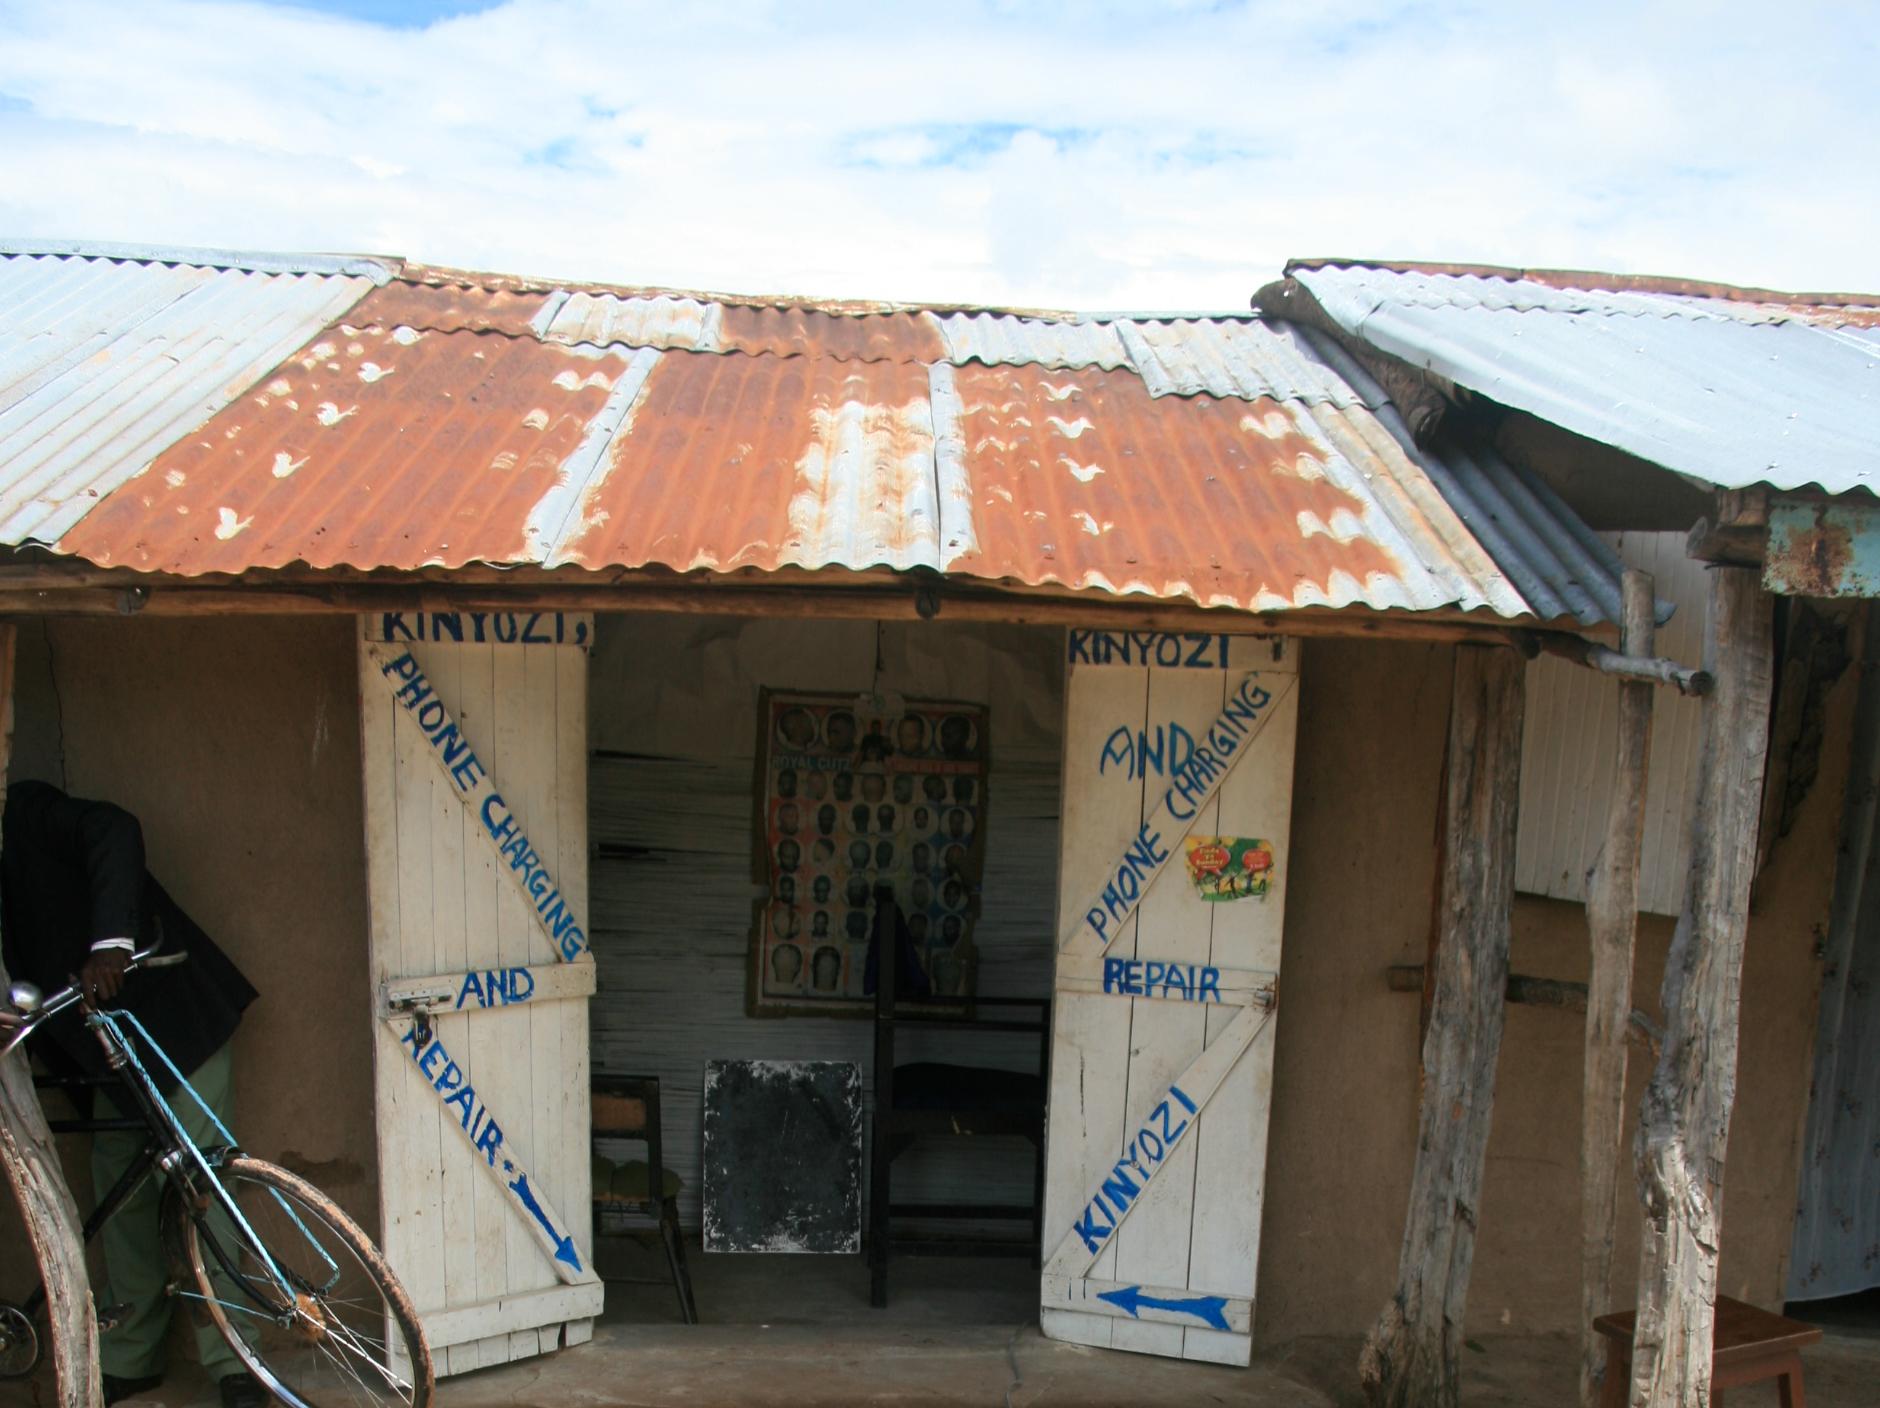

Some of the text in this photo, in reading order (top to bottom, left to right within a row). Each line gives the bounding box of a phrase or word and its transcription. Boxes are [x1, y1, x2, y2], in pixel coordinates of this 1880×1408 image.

[1069, 628, 1229, 668] KINYOZI
[382, 653, 486, 792] PHONE
[1099, 721, 1196, 781] AND
[1086, 671, 1271, 942] PHONE CHARGING
[456, 967, 535, 1009] AND
[1103, 957, 1221, 1003] REPAIR
[1073, 1085, 1199, 1256] KINYOZI
